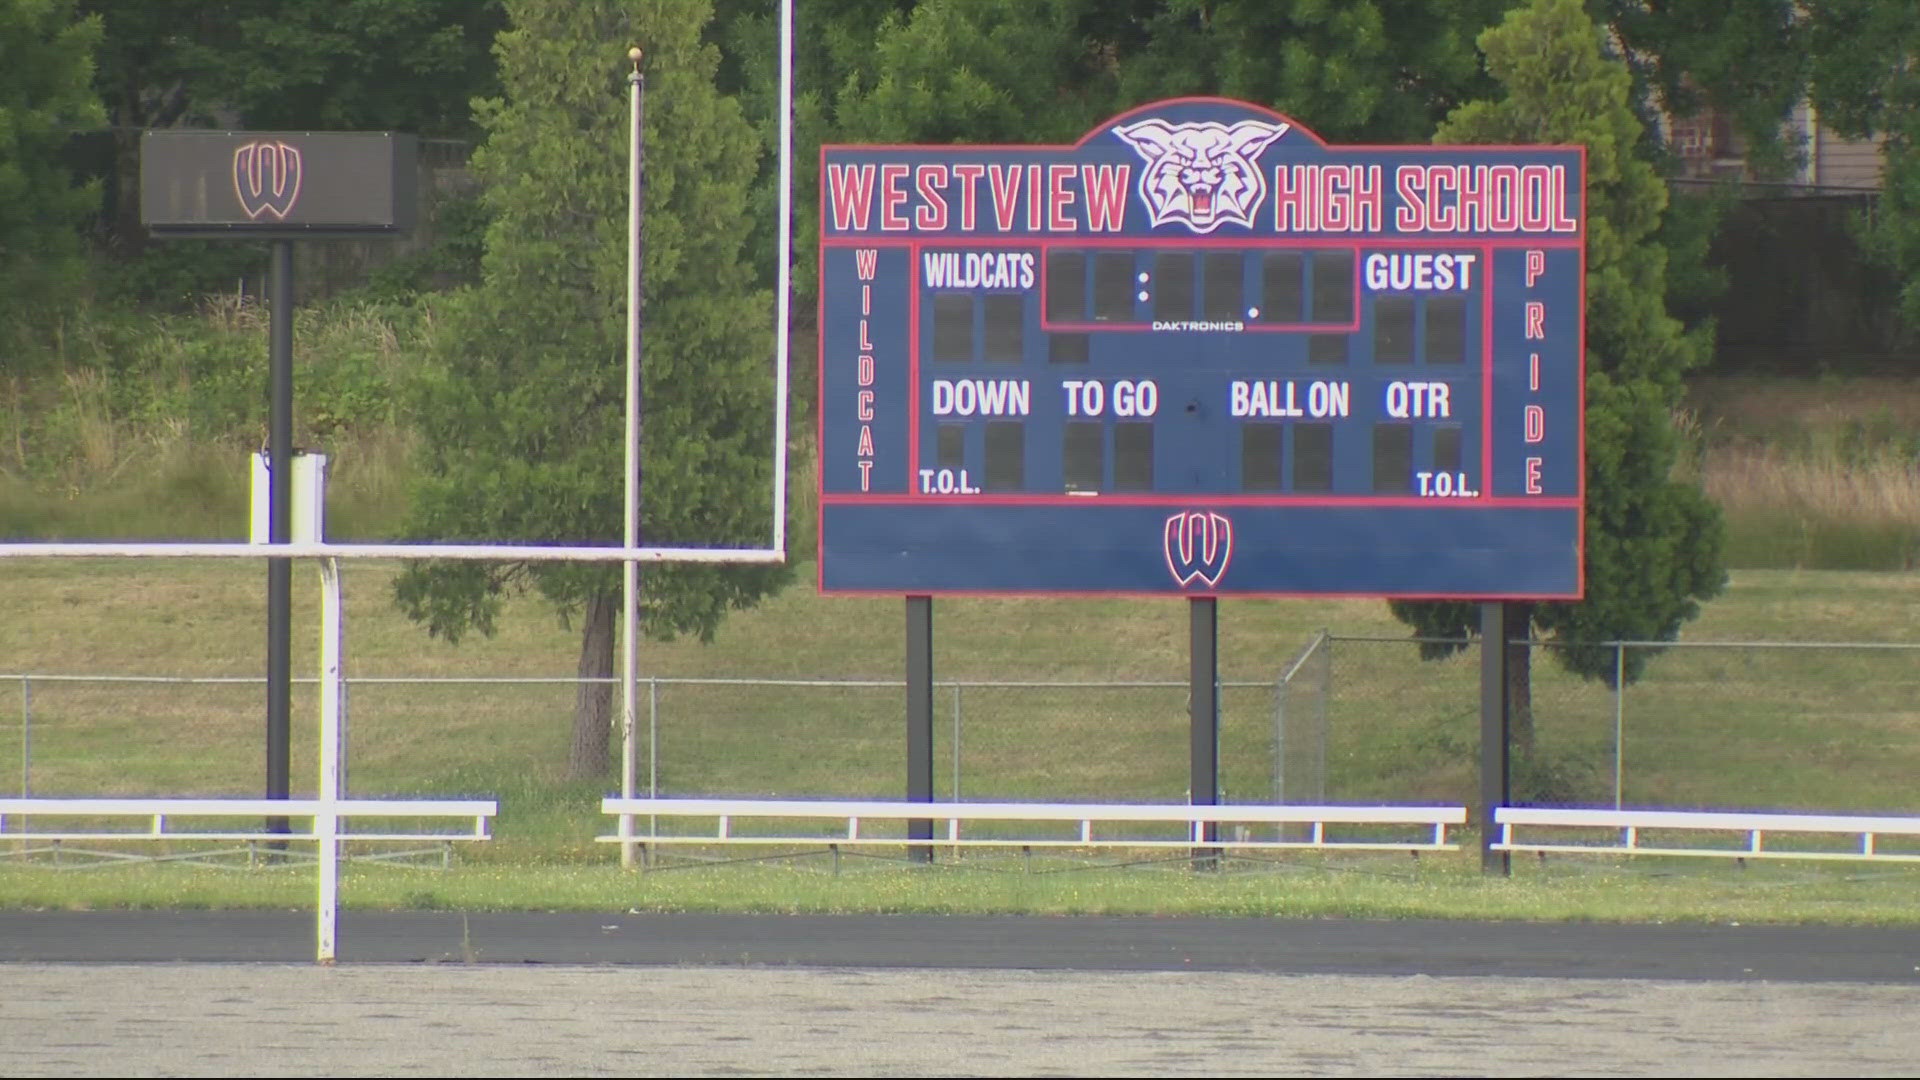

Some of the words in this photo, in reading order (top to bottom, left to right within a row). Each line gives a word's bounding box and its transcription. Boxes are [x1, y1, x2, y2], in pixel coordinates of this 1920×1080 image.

[828, 164, 1130, 232] WESTVIEW
[1274, 165, 1382, 232] HIGH
[1396, 165, 1576, 232] SCHOOL
[924, 252, 1035, 289] WILDCATS
[1365, 253, 1475, 290] GUEST
[1152, 320, 1244, 332] DAKTRONICS
[855, 249, 878, 492] WILDCAT
[1524, 250, 1545, 494] PRIDE
[932, 379, 1030, 416] DOWN
[1063, 380, 1105, 417] TO
[1113, 380, 1158, 417] GO
[1231, 381, 1303, 418] BALL
[1308, 381, 1350, 418] ON
[1385, 381, 1451, 419] QTR
[919, 469, 981, 494] T.O.L.
[1417, 472, 1479, 497] T.O.L.
